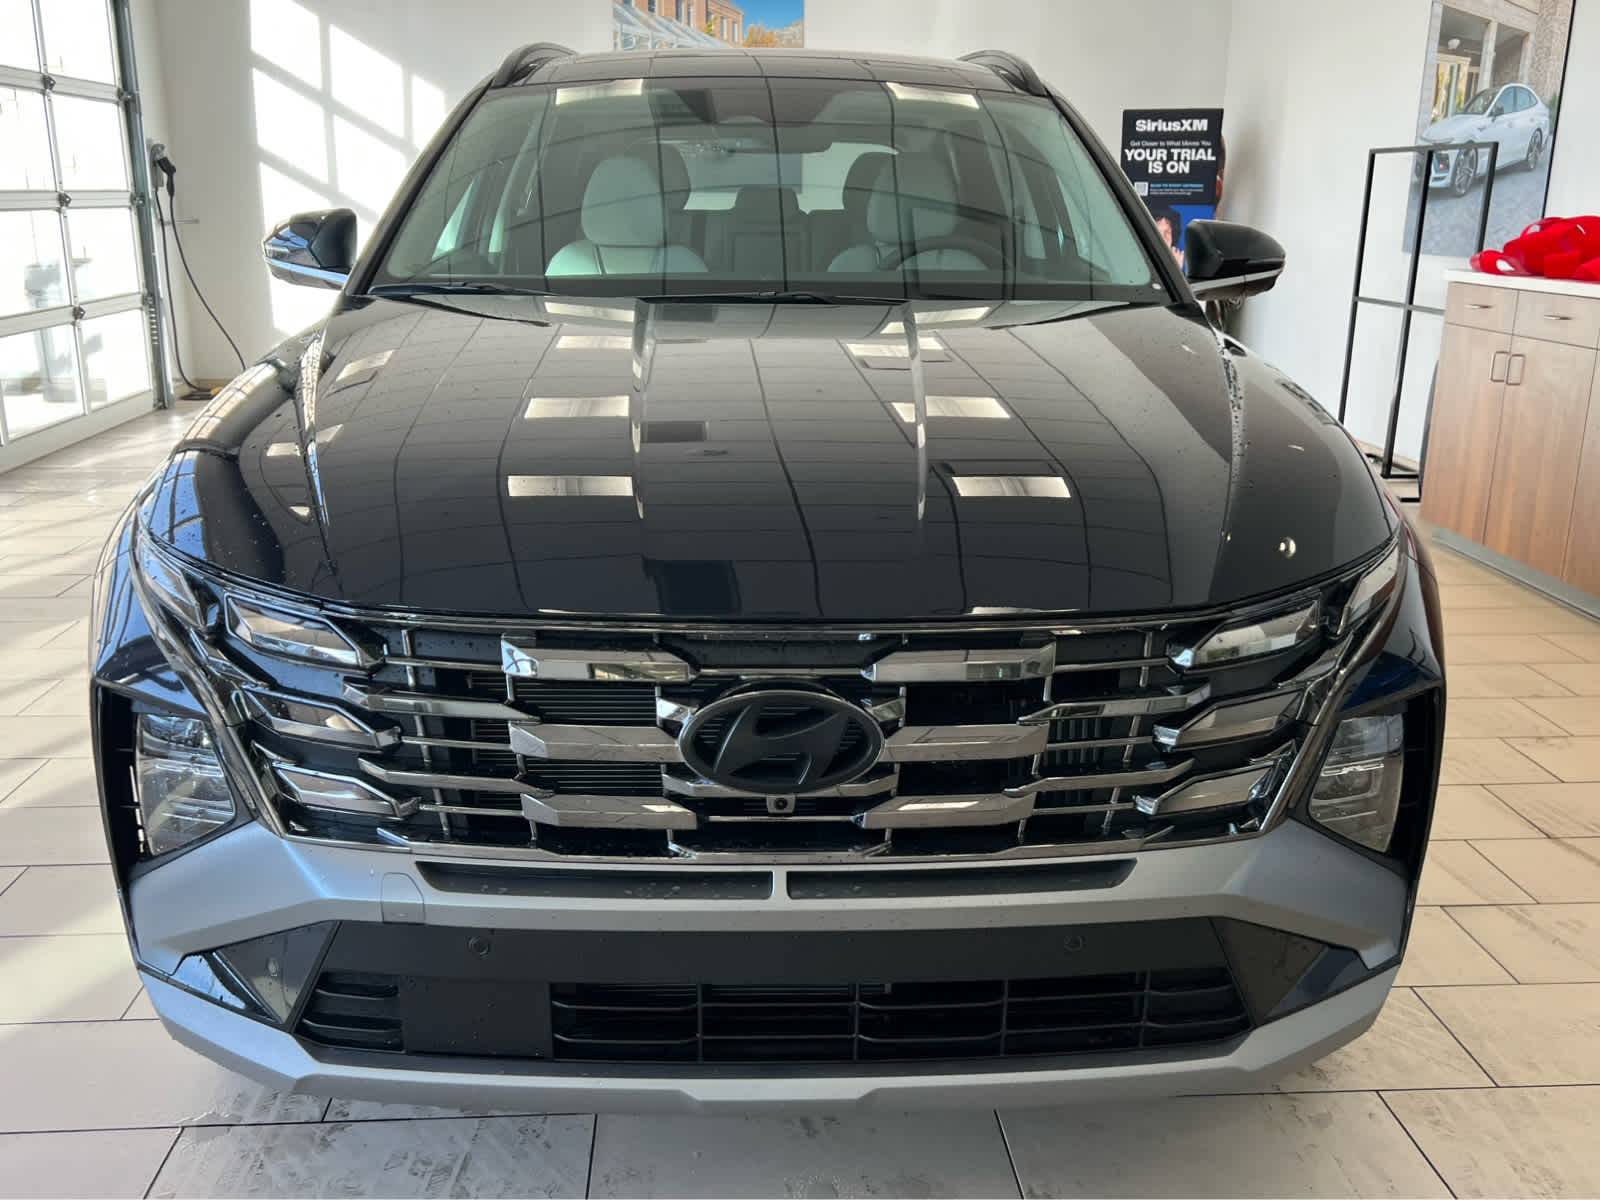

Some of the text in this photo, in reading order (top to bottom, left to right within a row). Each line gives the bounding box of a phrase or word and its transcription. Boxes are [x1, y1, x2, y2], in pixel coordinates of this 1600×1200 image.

[1135, 119, 1209, 132] SiriusXM
[1124, 148, 1217, 161] YOUR TRIAL
[1148, 161, 1190, 174] IS ON
